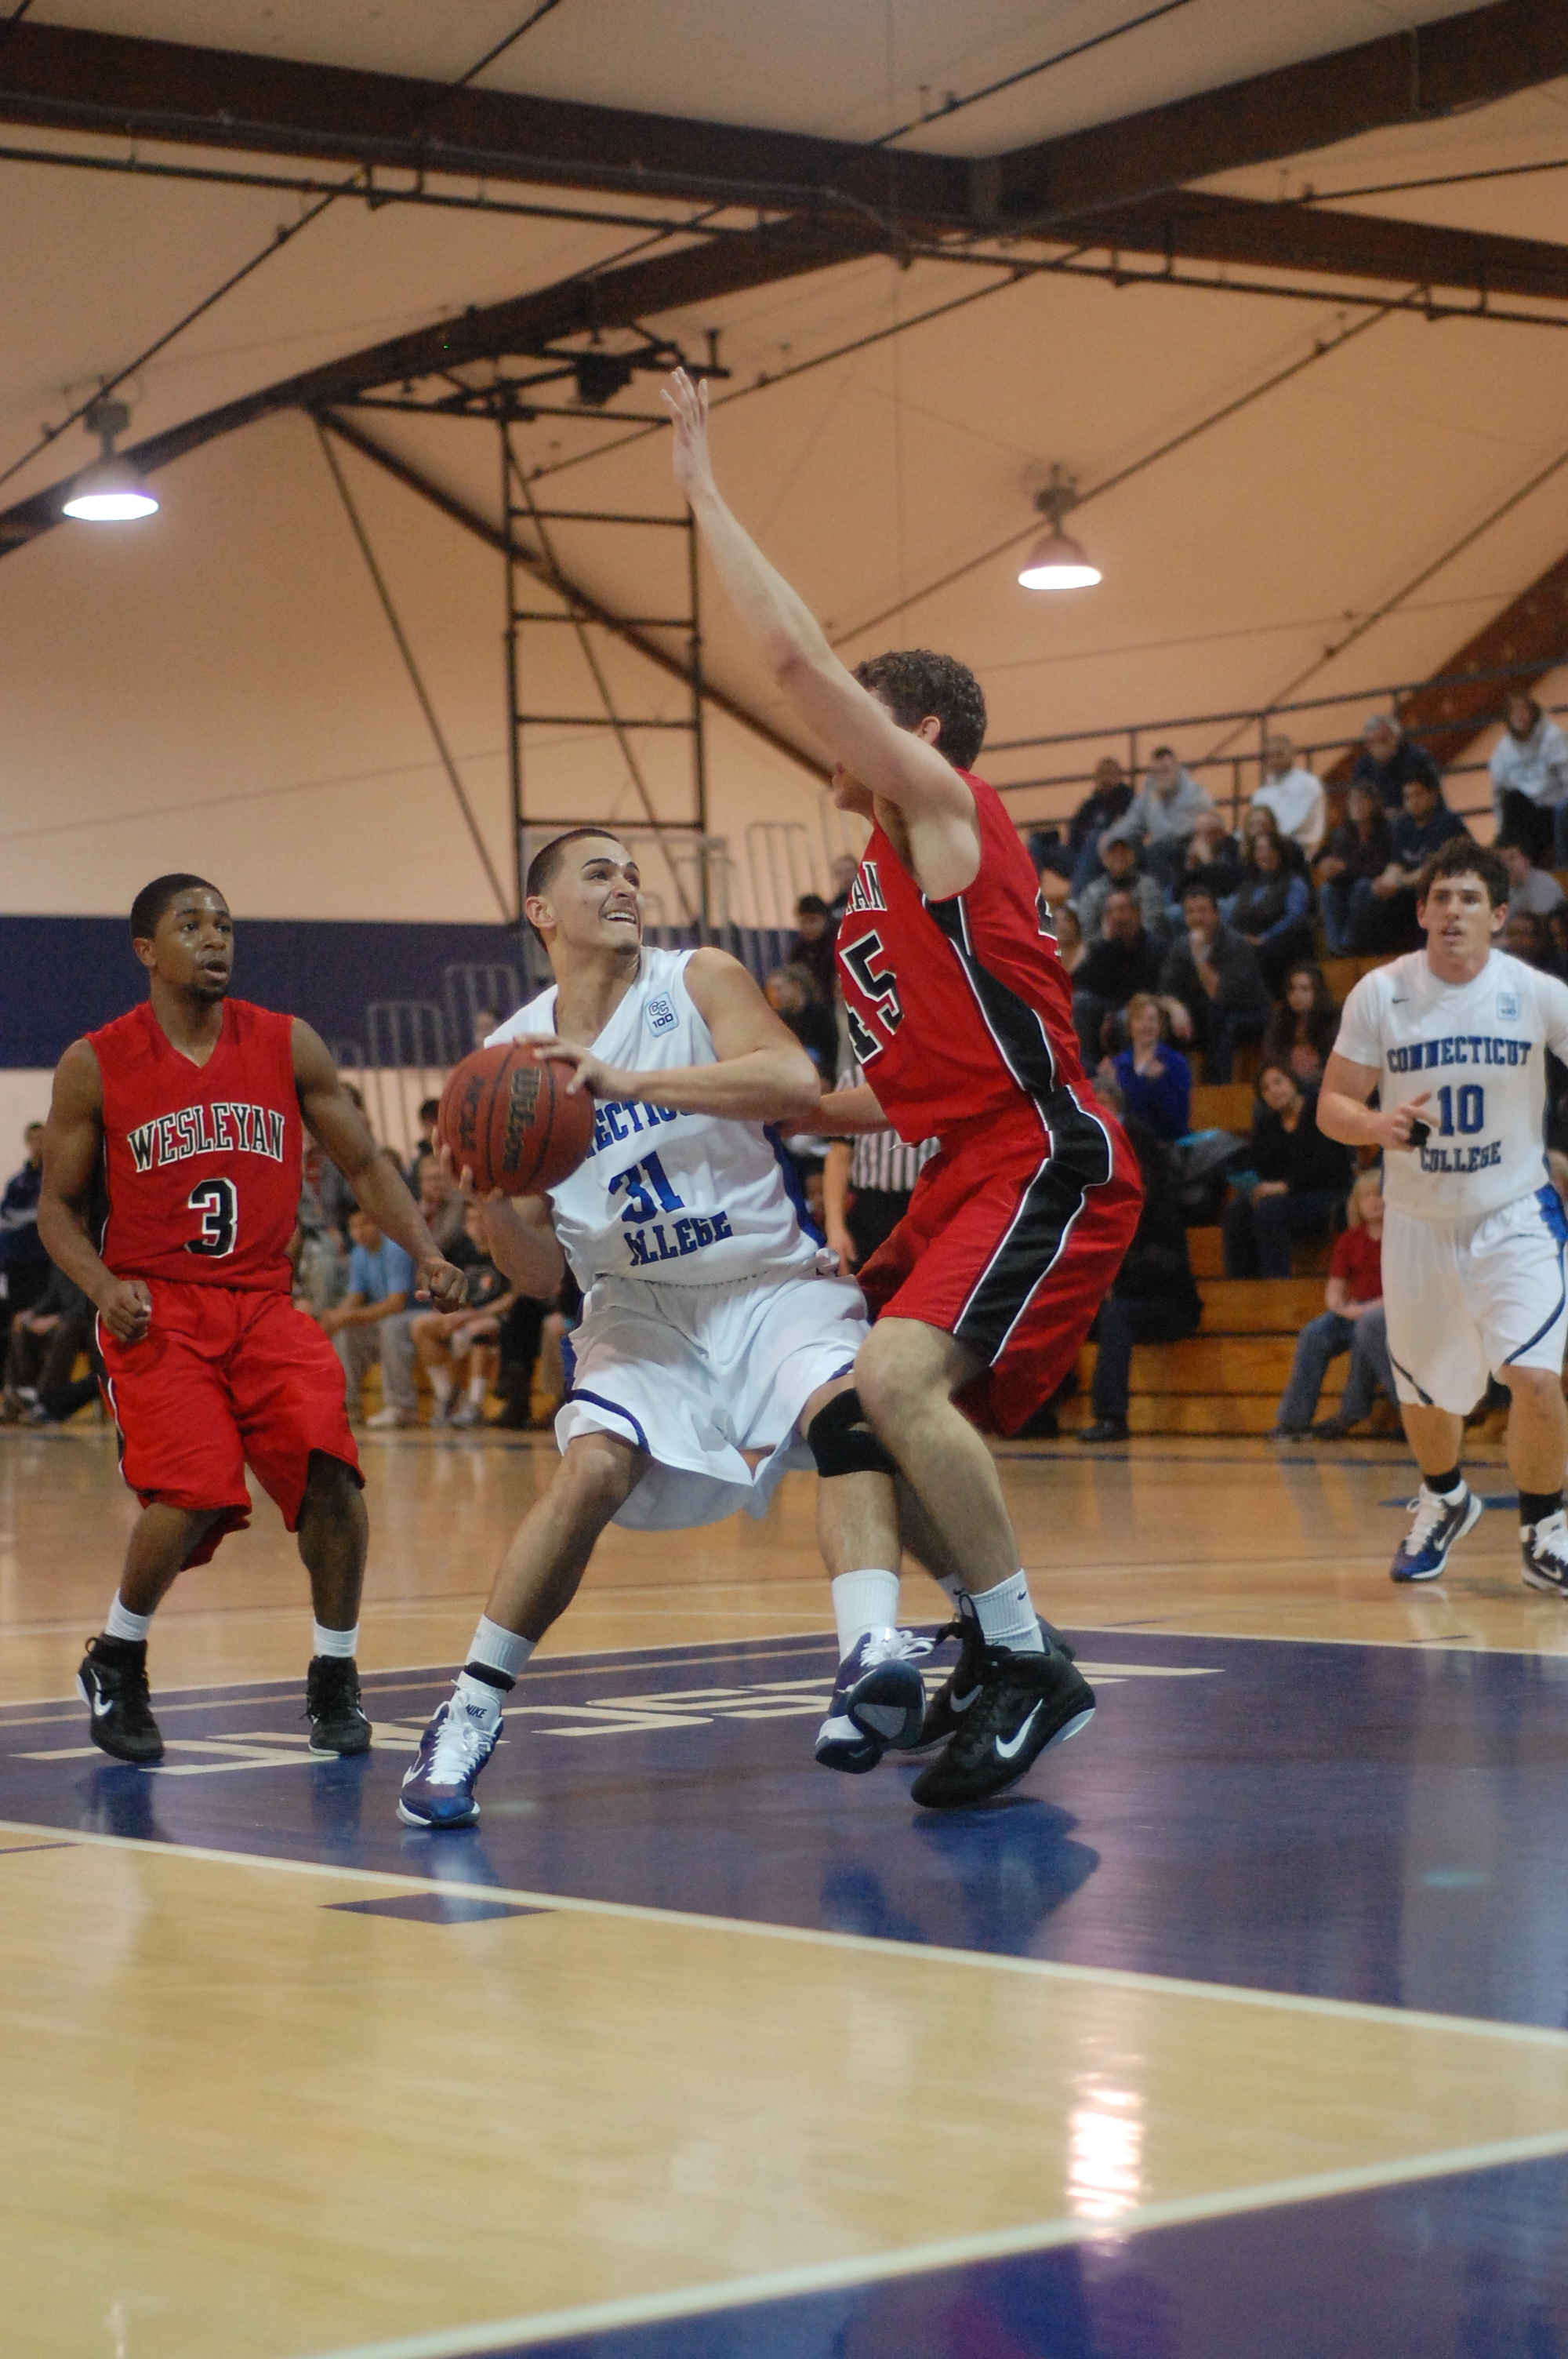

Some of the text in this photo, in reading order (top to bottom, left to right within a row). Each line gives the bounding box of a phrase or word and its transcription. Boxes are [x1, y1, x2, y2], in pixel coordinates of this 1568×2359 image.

[846, 861, 888, 916] AN
[648, 1000, 670, 1016] CC
[652, 1012, 674, 1028] 100
[1386, 1035, 1533, 1074] CONNECTICUT
[1437, 1083, 1484, 1137] 10
[126, 1102, 285, 1173] WESLEYAN
[1420, 1140, 1502, 1173] COLLEGE
[608, 1150, 686, 1225] 31
[184, 1176, 238, 1259] 3
[465, 1703, 488, 1719] NIKE
